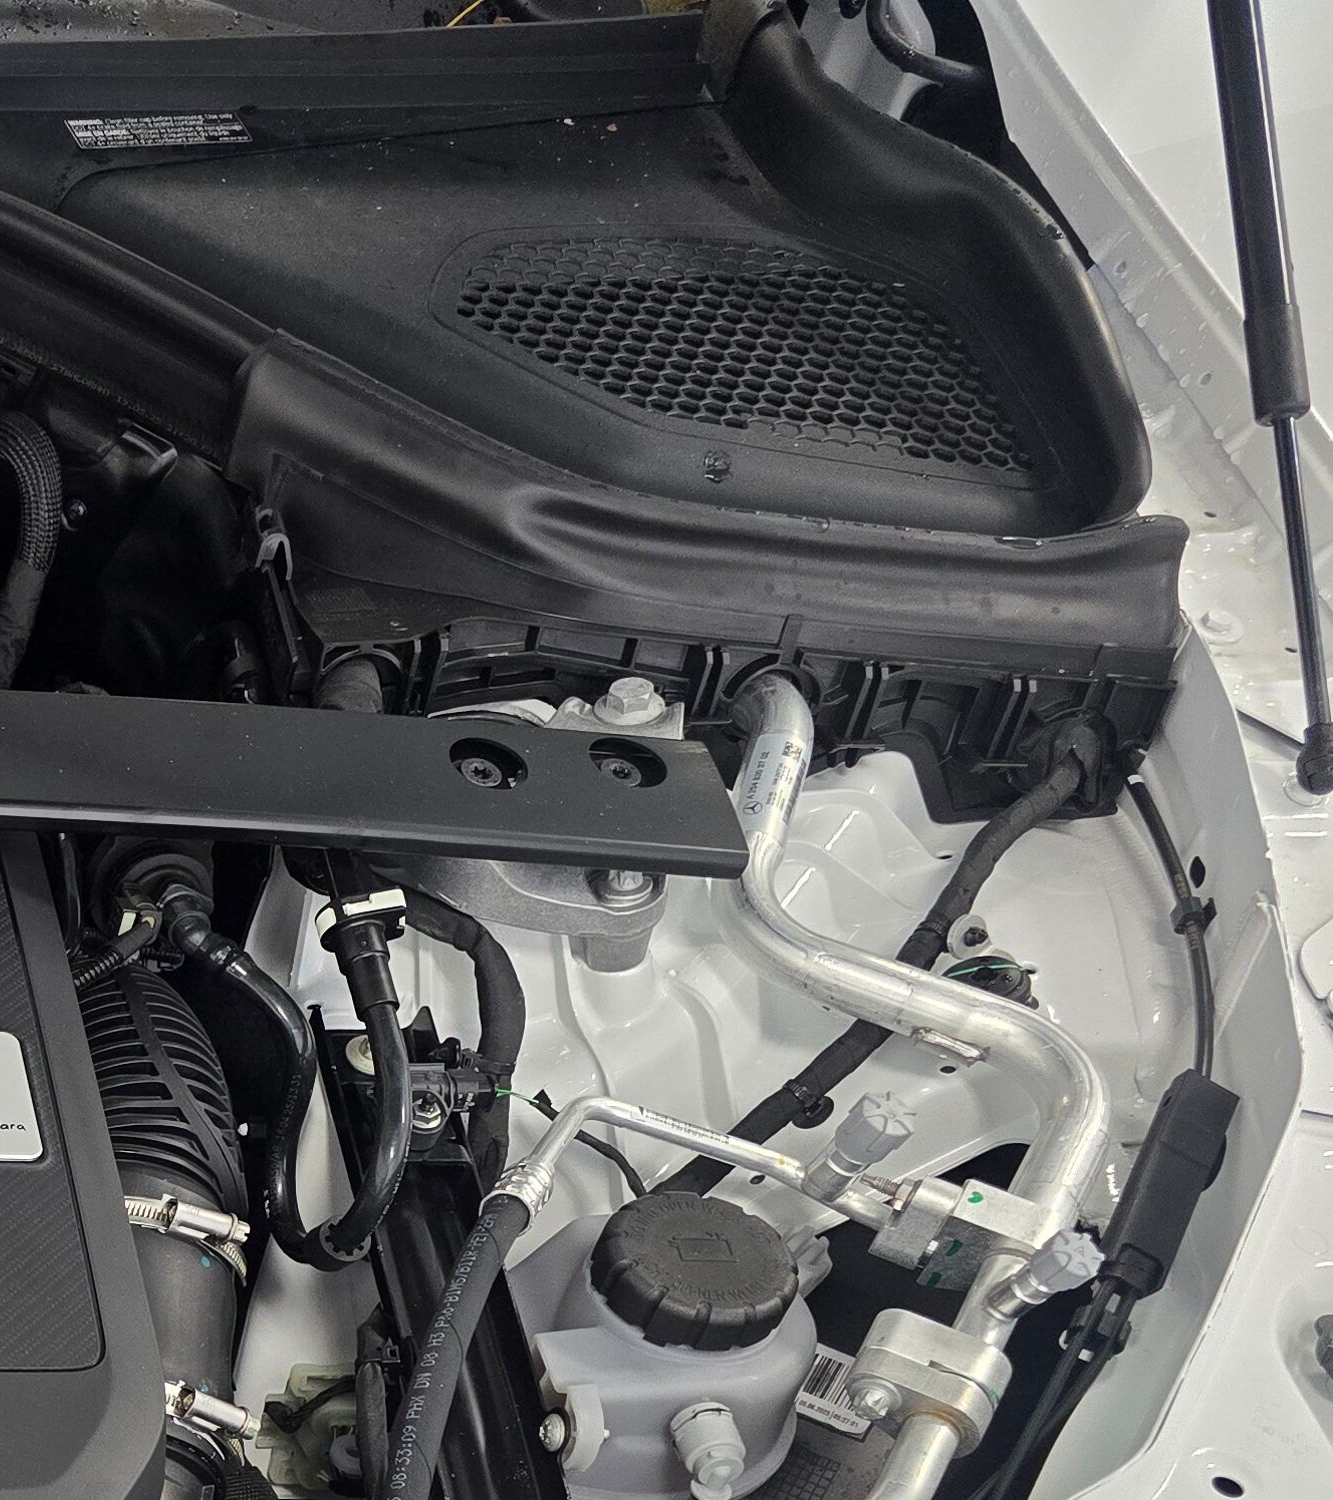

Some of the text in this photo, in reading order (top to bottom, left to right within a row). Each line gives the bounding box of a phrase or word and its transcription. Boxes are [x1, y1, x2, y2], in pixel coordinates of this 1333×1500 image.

[390, 1425, 417, 1491] 08:33:09
[406, 1393, 426, 1421] PHX
[420, 1350, 440, 1368] 08
